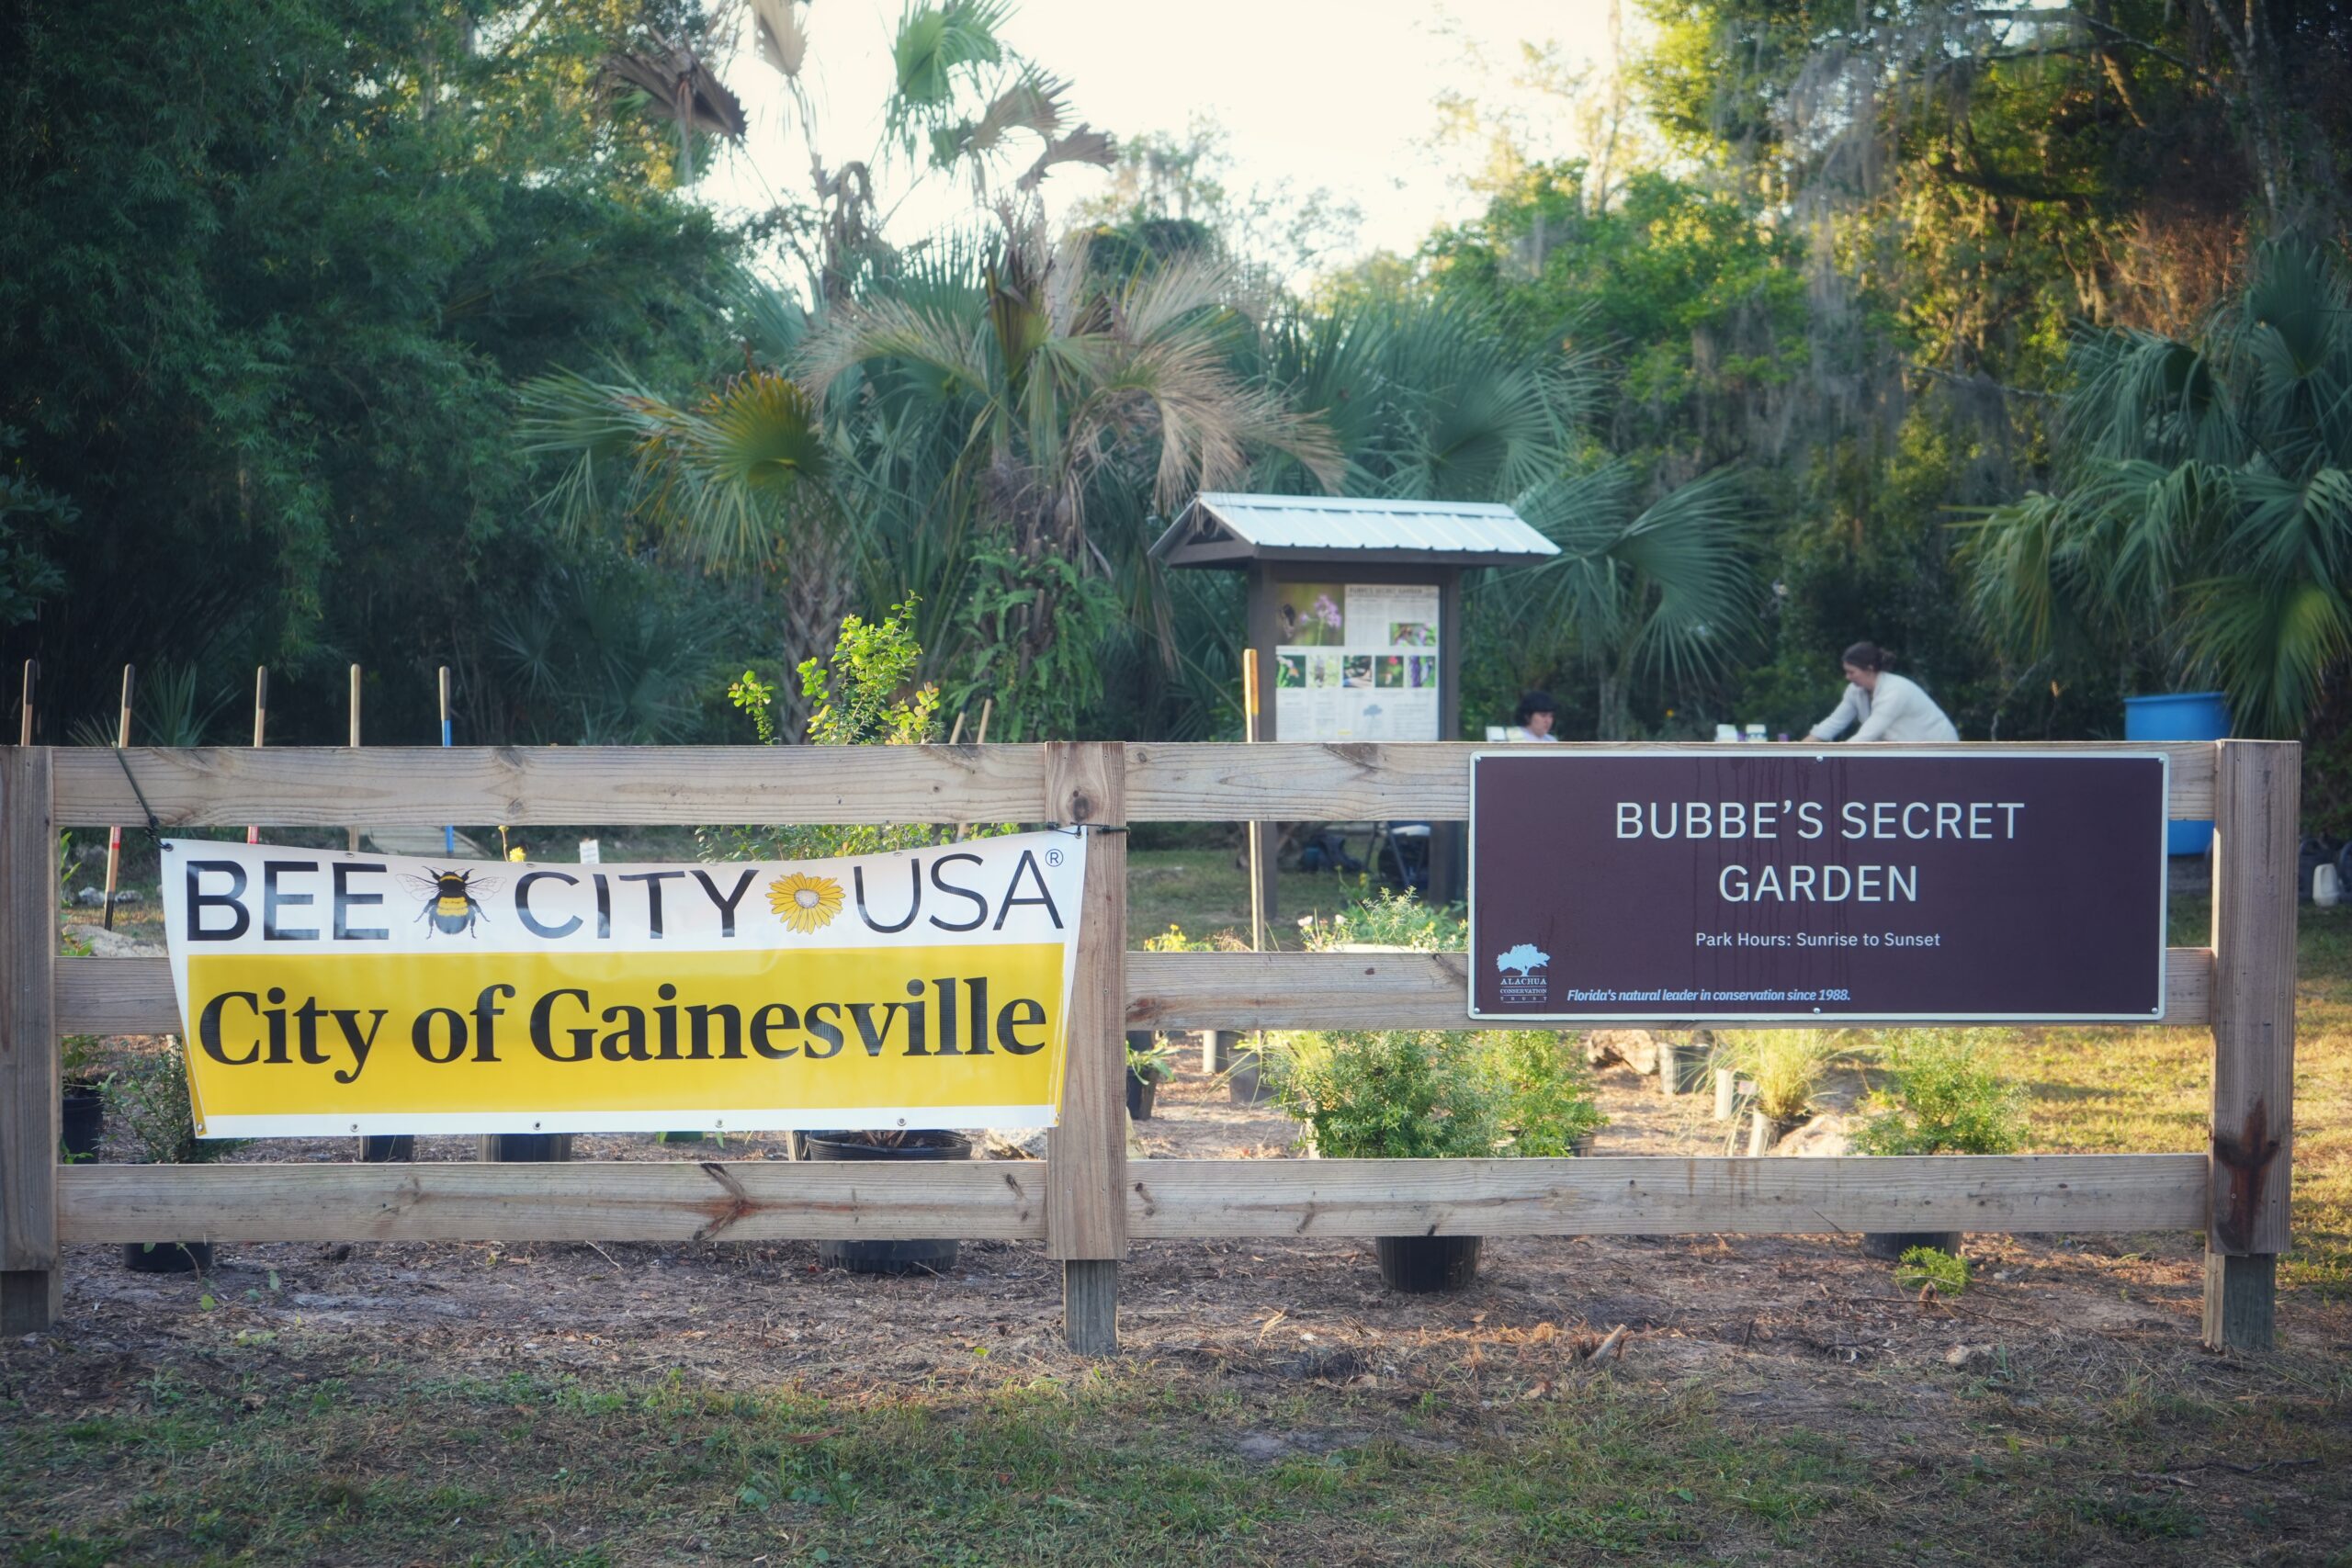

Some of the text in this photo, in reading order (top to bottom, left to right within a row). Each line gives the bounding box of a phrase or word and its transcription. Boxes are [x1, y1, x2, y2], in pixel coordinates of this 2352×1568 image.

[1841, 801, 2025, 840] SECRET
[186, 860, 390, 942] BEE
[514, 868, 758, 940] CITY
[1719, 864, 1917, 902] GARDEN
[1695, 931, 1941, 947] Park Hours: Sunrise to Sunset
[1499, 977, 1548, 986] ALACHUA
[1566, 988, 1851, 1001] Florida's natural leader in conservation since 1988.
[198, 976, 1046, 1085] City of Gainesville
